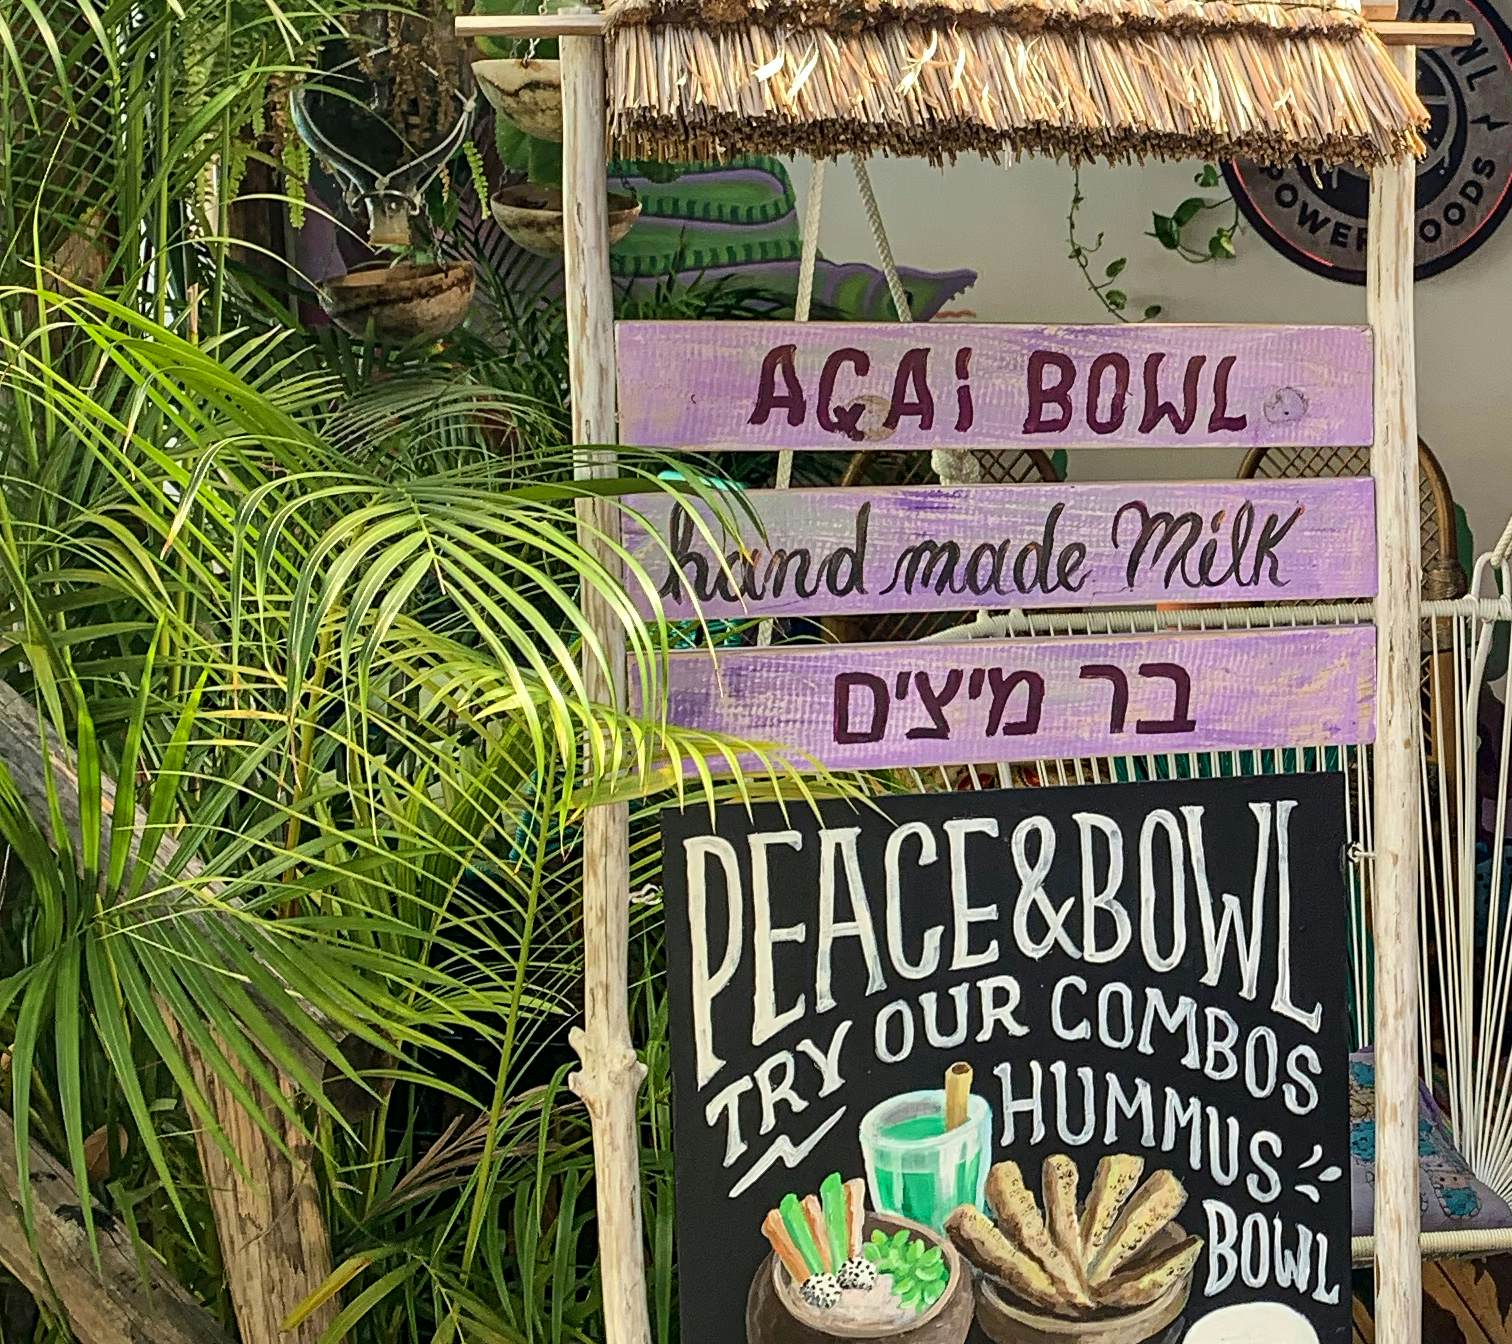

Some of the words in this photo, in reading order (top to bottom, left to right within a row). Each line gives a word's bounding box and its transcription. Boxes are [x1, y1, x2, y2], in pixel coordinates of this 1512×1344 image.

[1419, 157, 1496, 243] OODS
[1022, 349, 1248, 436] BOWL
[660, 498, 870, 603] hand
[880, 501, 1086, 598] made
[833, 664, 1046, 745] מיצים
[1079, 662, 1197, 736] בר
[705, 1020, 853, 1167] TRY
[874, 975, 1030, 1063] OUR
[1050, 975, 1321, 1116] COMBOS
[993, 1059, 1283, 1204] HUMMUS
[1201, 1198, 1341, 1306] BOWL
